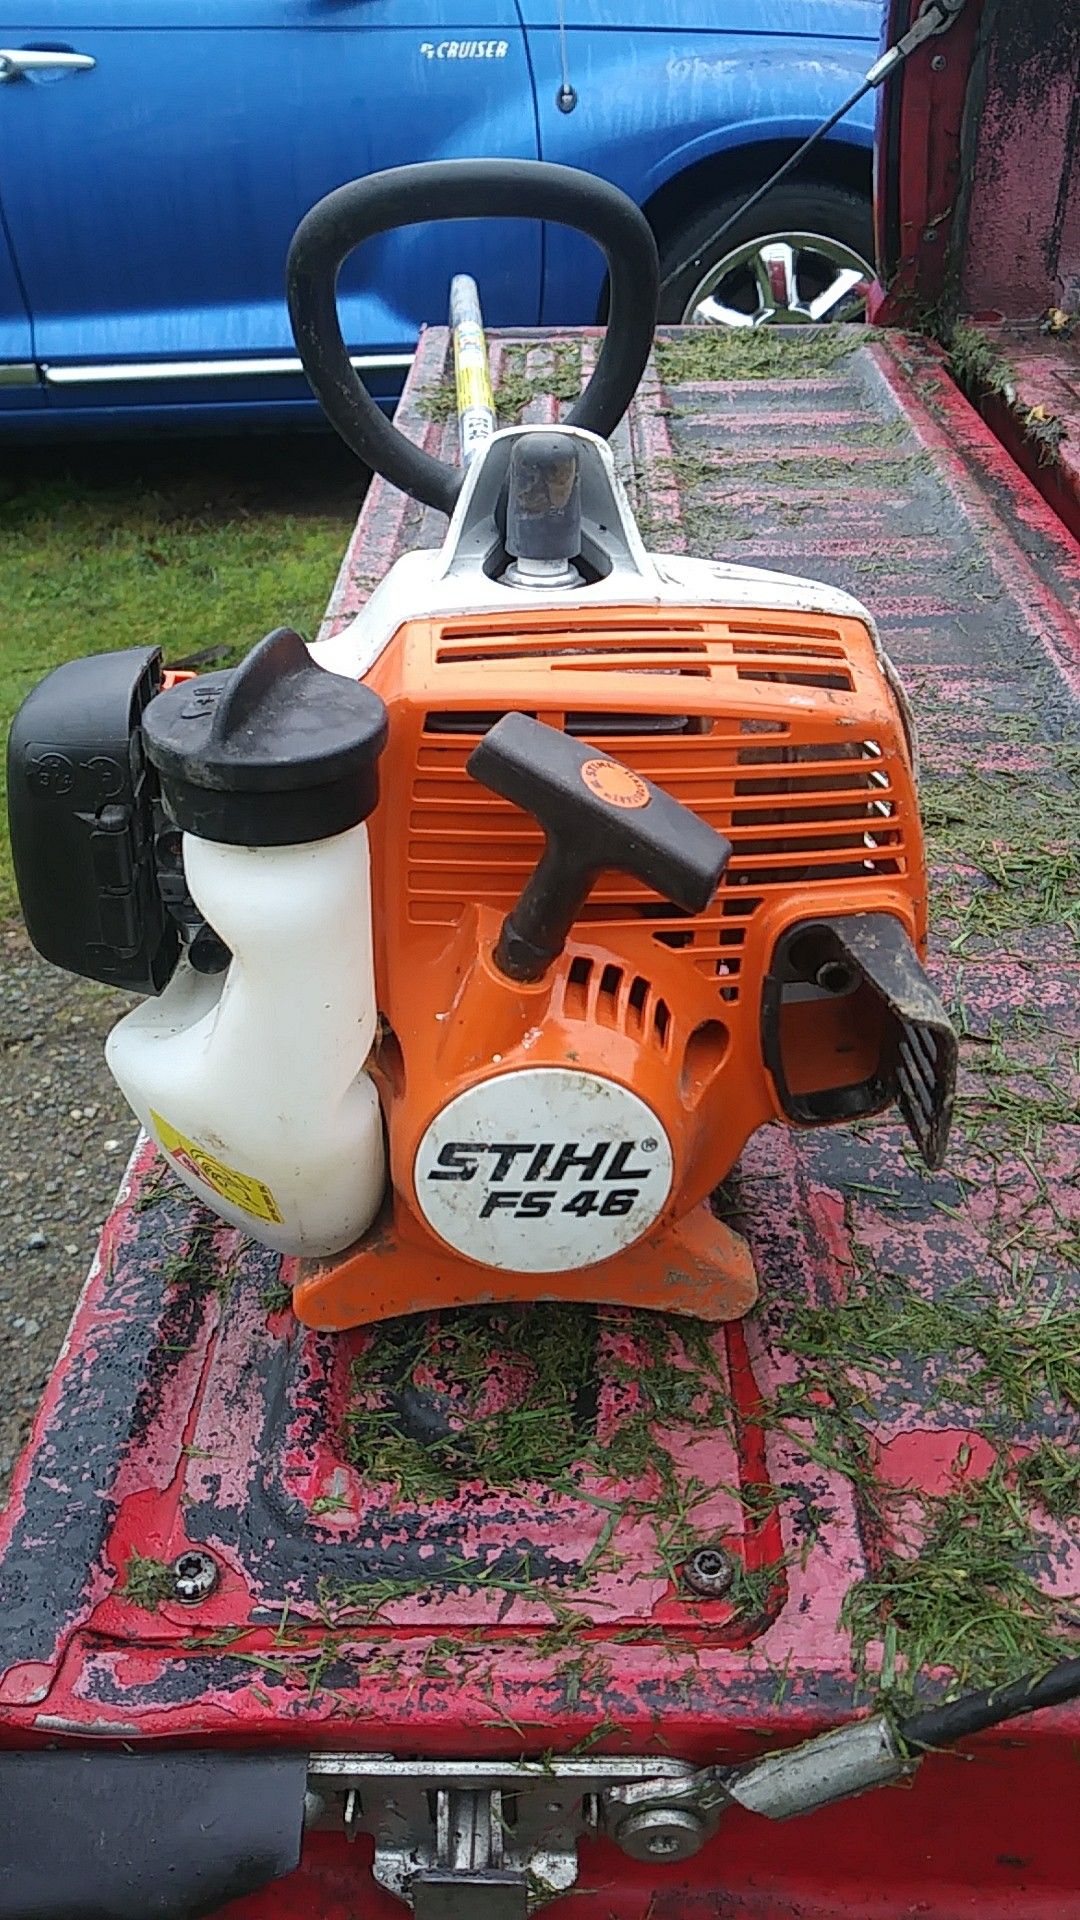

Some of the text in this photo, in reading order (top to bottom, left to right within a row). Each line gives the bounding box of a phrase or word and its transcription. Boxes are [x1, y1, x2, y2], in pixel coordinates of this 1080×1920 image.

[436, 40, 509, 59] CRUISER
[427, 1140, 652, 1182] STIHL
[478, 1188, 640, 1219] FS 46
